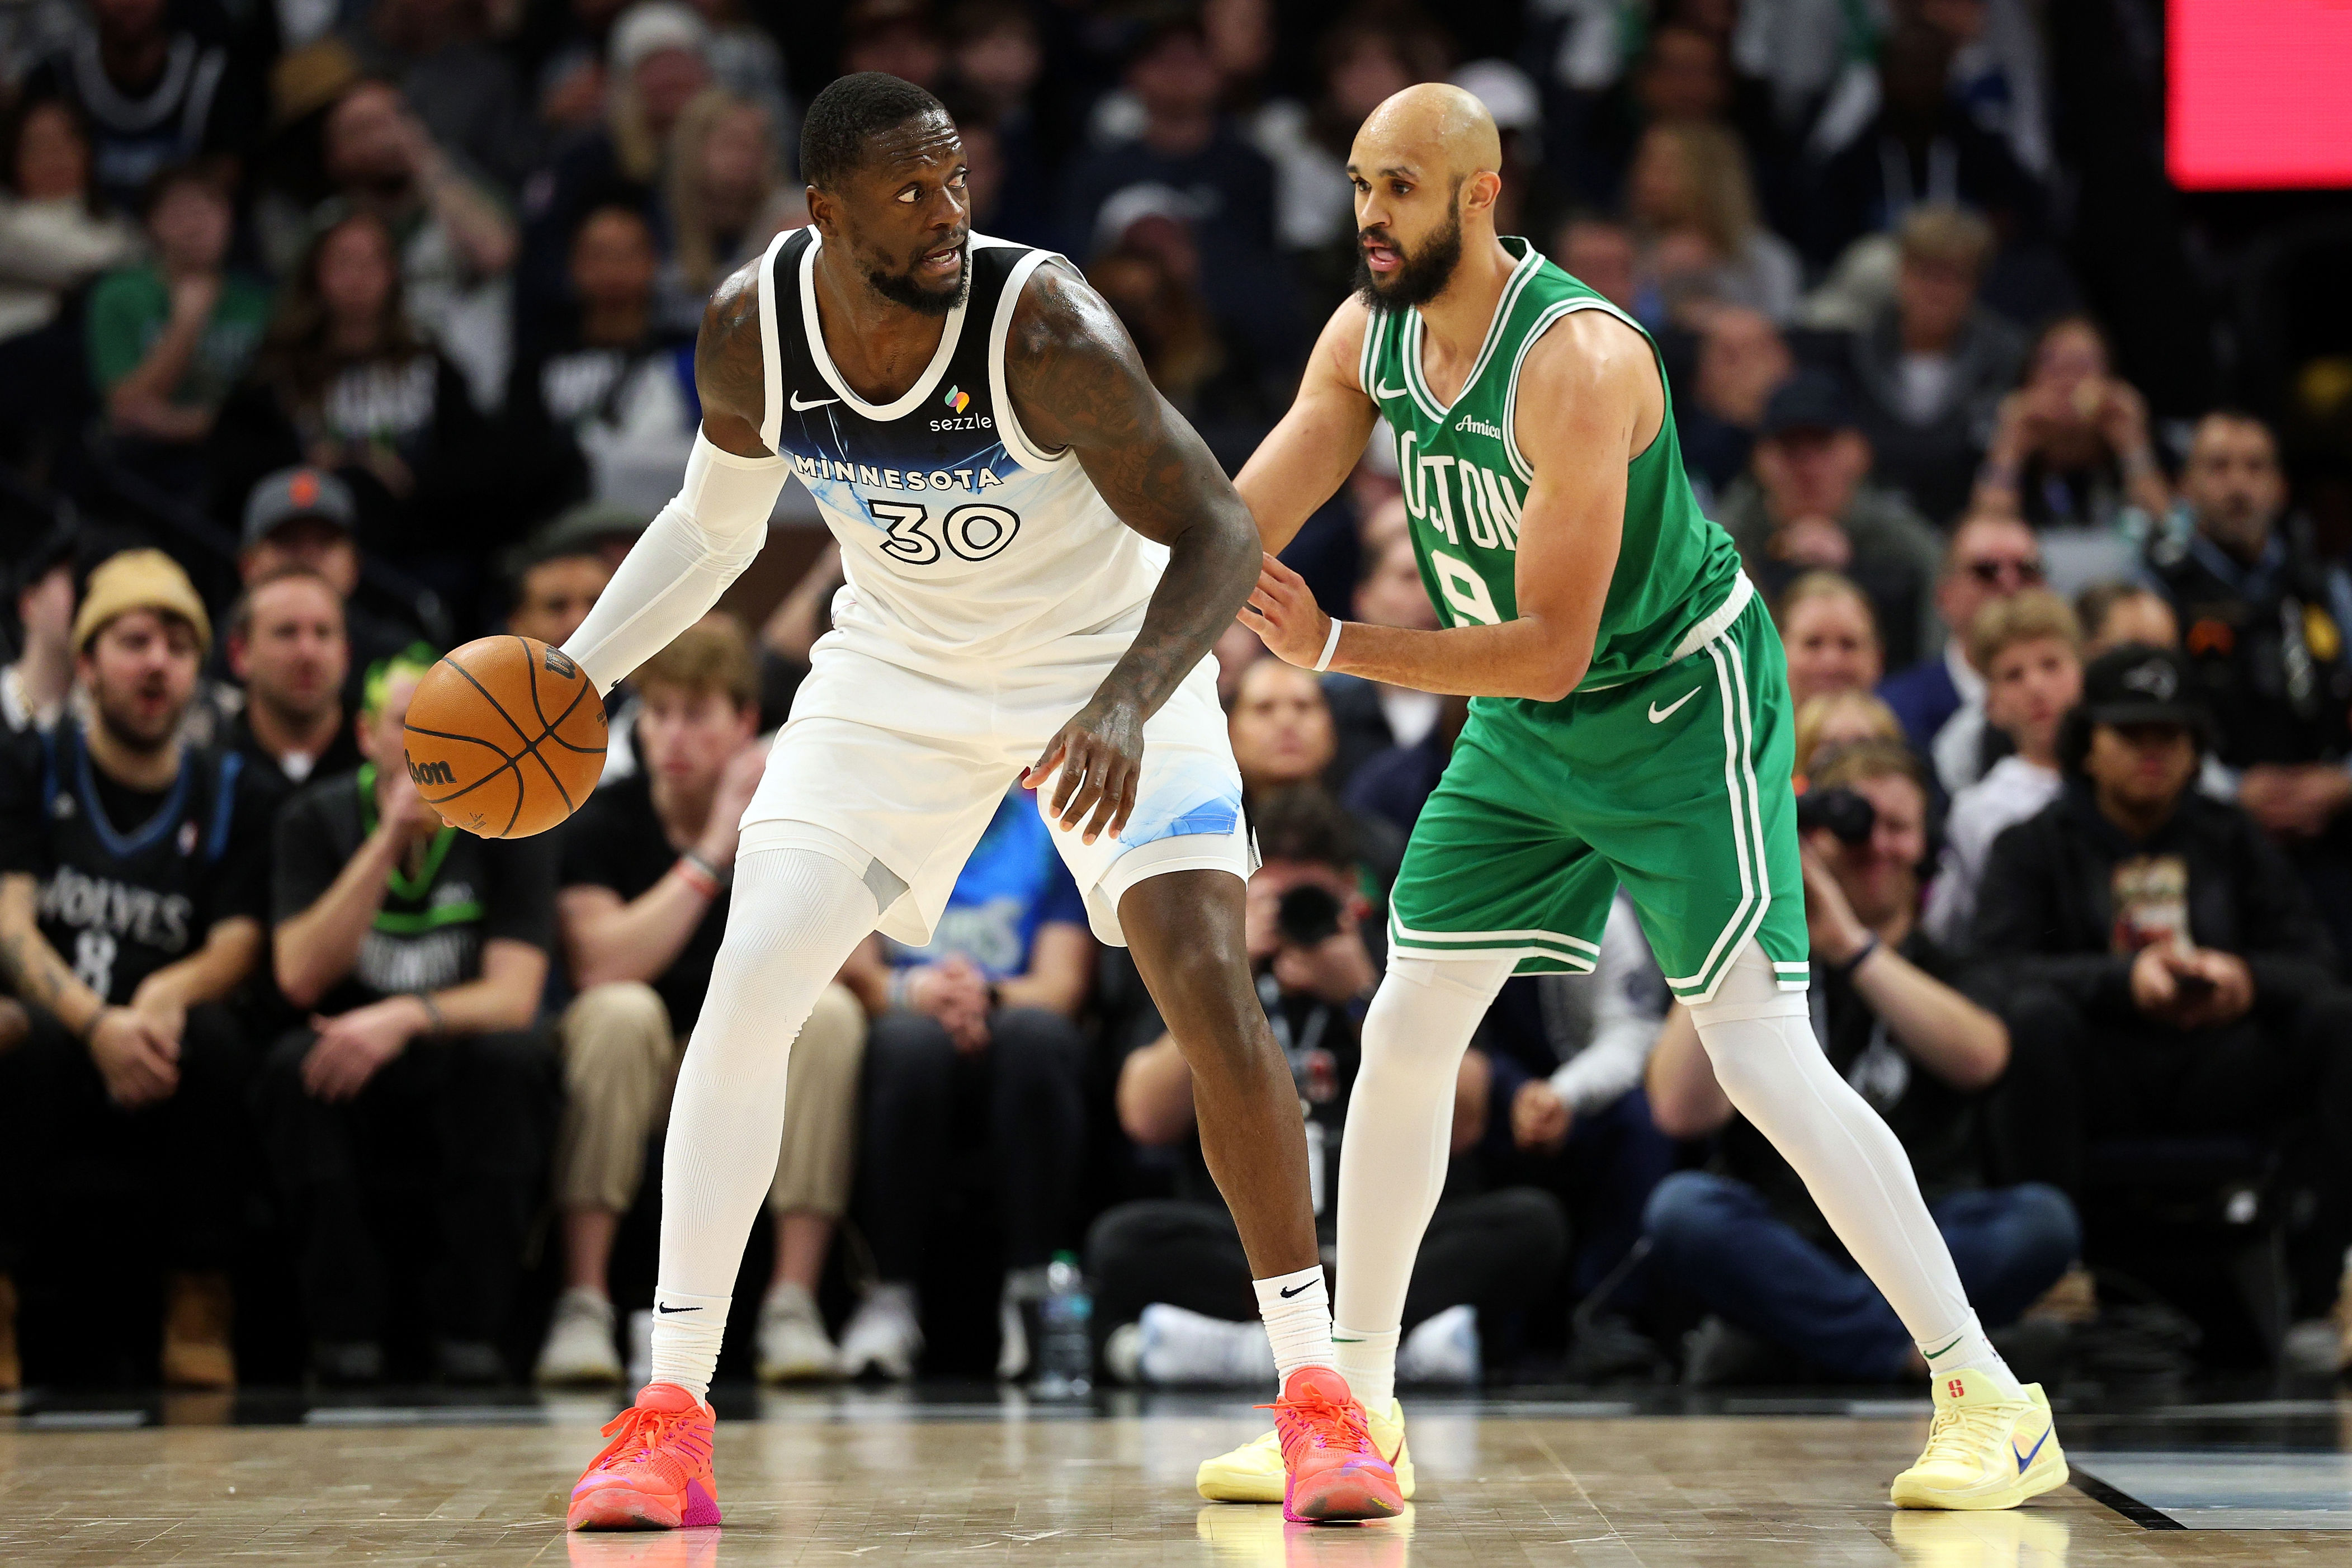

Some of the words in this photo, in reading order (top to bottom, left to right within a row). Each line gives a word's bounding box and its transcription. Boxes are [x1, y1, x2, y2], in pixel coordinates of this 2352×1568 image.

[929, 413, 992, 432] sezzle
[1455, 414, 1501, 441] Amica
[793, 454, 1004, 492] MINNESOTA
[1401, 430, 1522, 551] OTON
[867, 499, 1021, 565] 30
[75, 929, 116, 1004] 8
